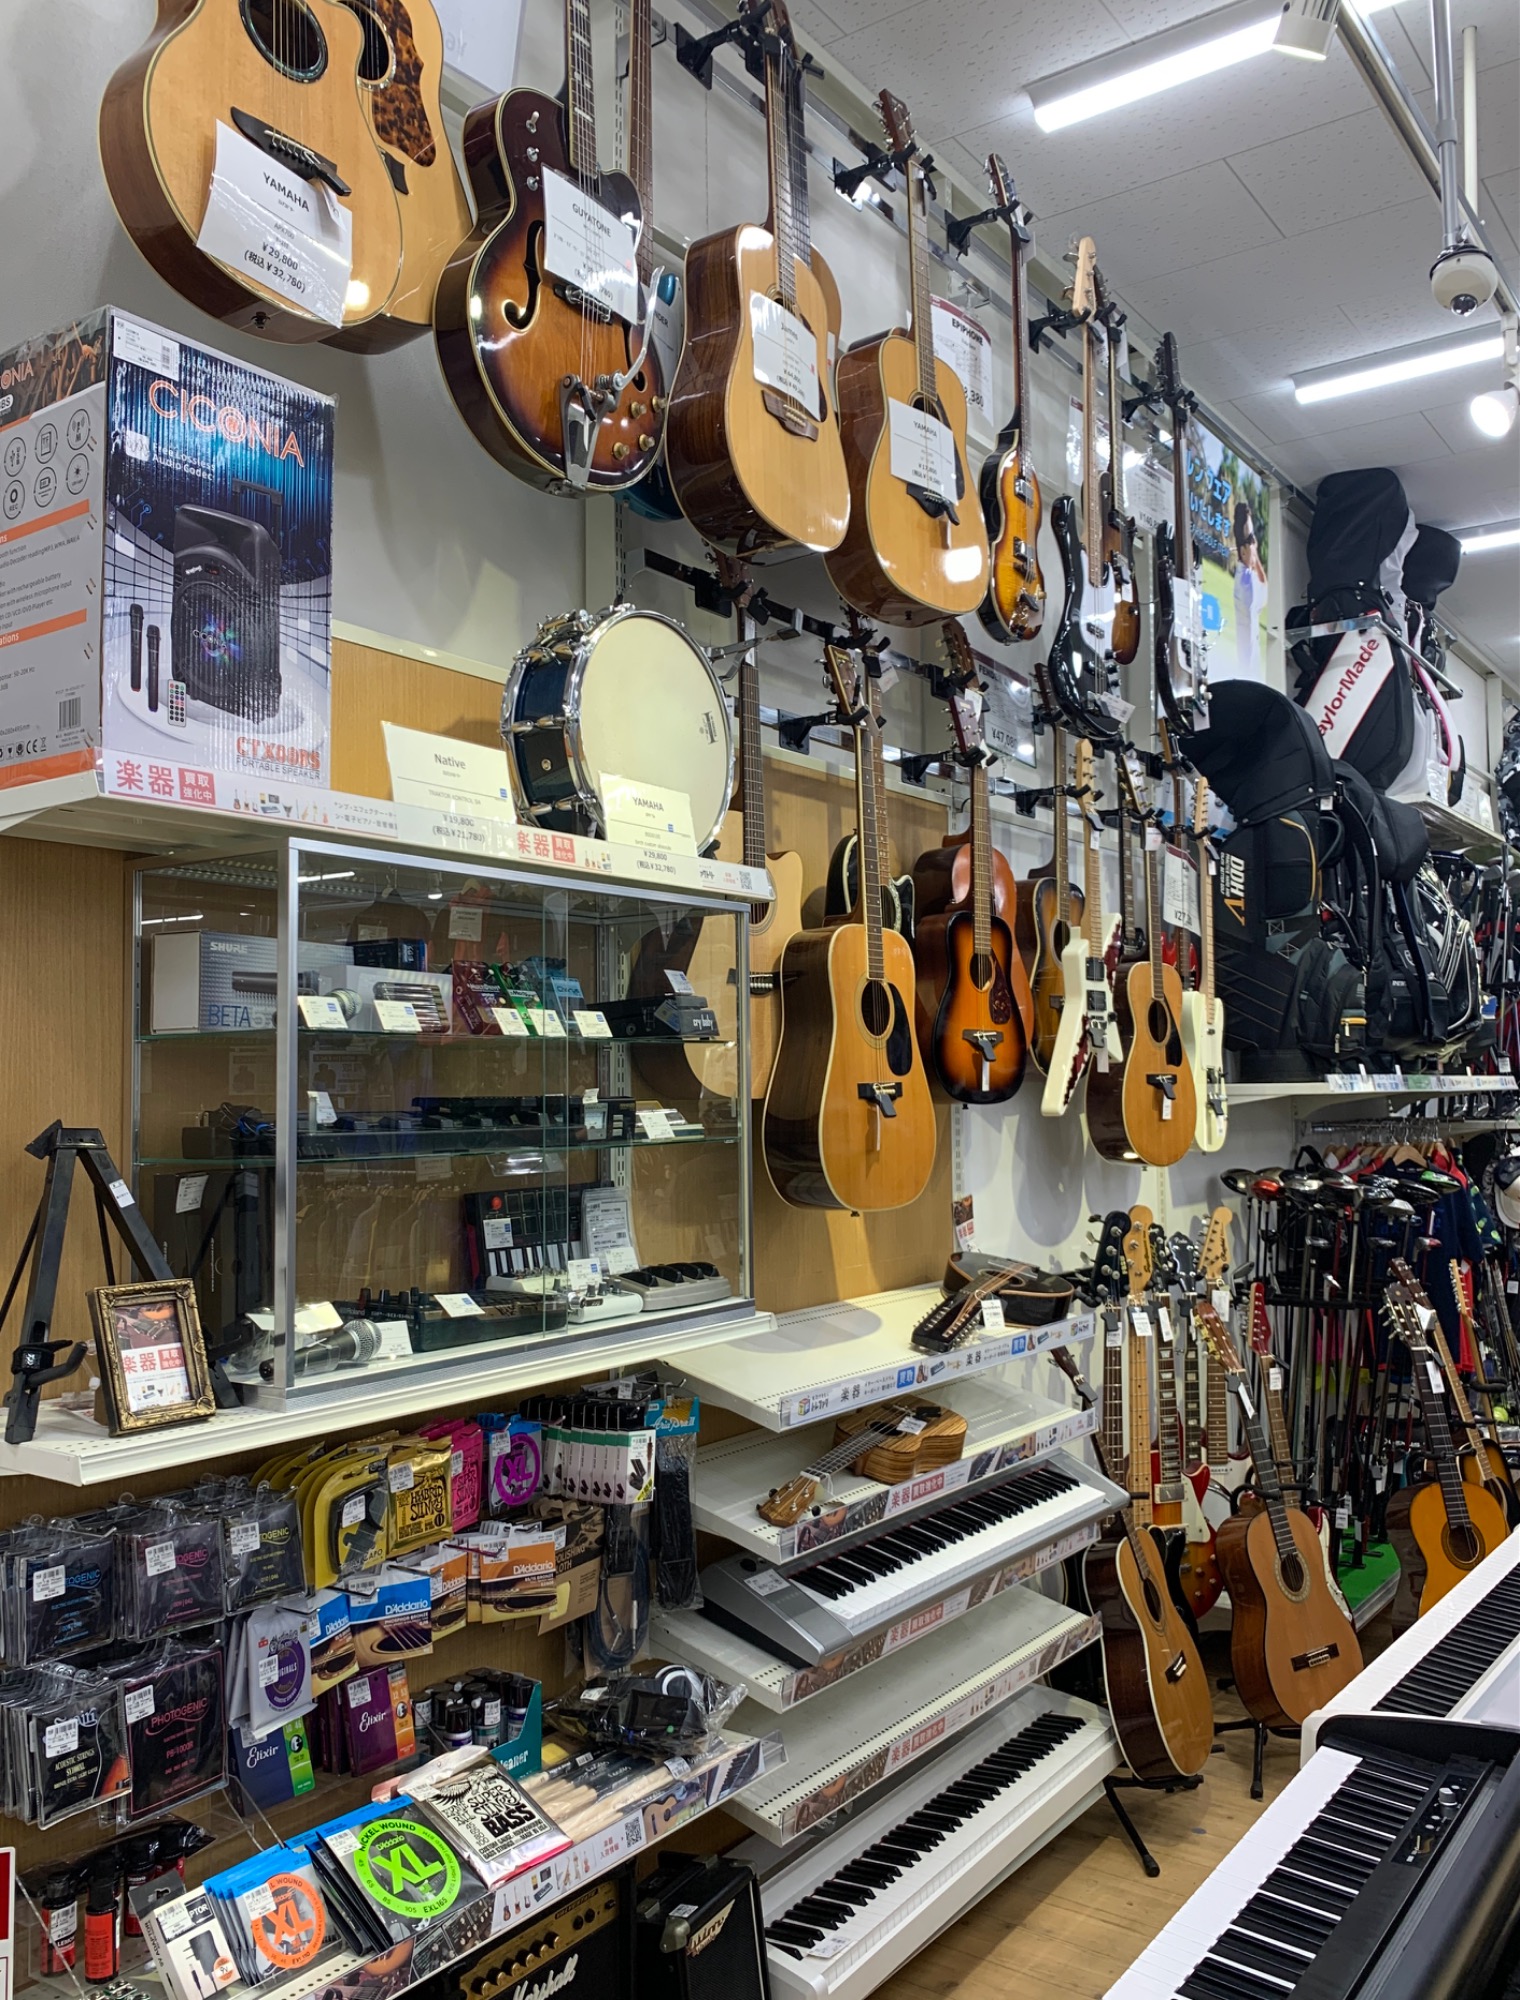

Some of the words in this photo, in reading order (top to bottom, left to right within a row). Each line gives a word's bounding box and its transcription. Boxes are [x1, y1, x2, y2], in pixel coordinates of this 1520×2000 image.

[263, 172, 309, 212] YAMAHA
[572, 203, 612, 238] GUYATONE
[262, 242, 298, 270] ¥29,800
[0, 359, 34, 389] ONIA
[149, 379, 304, 468] CICONIA
[913, 420, 938, 439] YAMAHA
[152, 454, 181, 471] Audio
[1318, 638, 1380, 738] aylorMade
[236, 756, 281, 775] PORTABLE
[282, 765, 320, 781] SPEAKER
[434, 752, 467, 771] Native
[116, 760, 175, 797] 楽器
[184, 771, 211, 788] 買取
[182, 786, 213, 802] 強化中
[632, 796, 664, 812] YAMAHA
[517, 829, 551, 858] 楽器
[210, 941, 249, 954] SHURE
[208, 1004, 251, 1027] BETA
[123, 1351, 157, 1375] 楽器
[505, 1455, 533, 1486] XL
[513, 1560, 554, 1575] D'Addario
[385, 1599, 428, 1616] D'Addario
[151, 1697, 208, 1728] PHOTOGENIC
[359, 1711, 387, 1732] Elixir
[246, 1745, 280, 1769] Elixir
[500, 1750, 529, 1772] leaner
[468, 1784, 512, 1808] SUPER
[379, 1821, 416, 1832] WOUND
[482, 1804, 537, 1838] BASS
[371, 1843, 445, 1895] XL
[276, 1877, 303, 1888] WOUND
[189, 1903, 209, 1918] PTOR
[265, 1899, 313, 1945] XL
